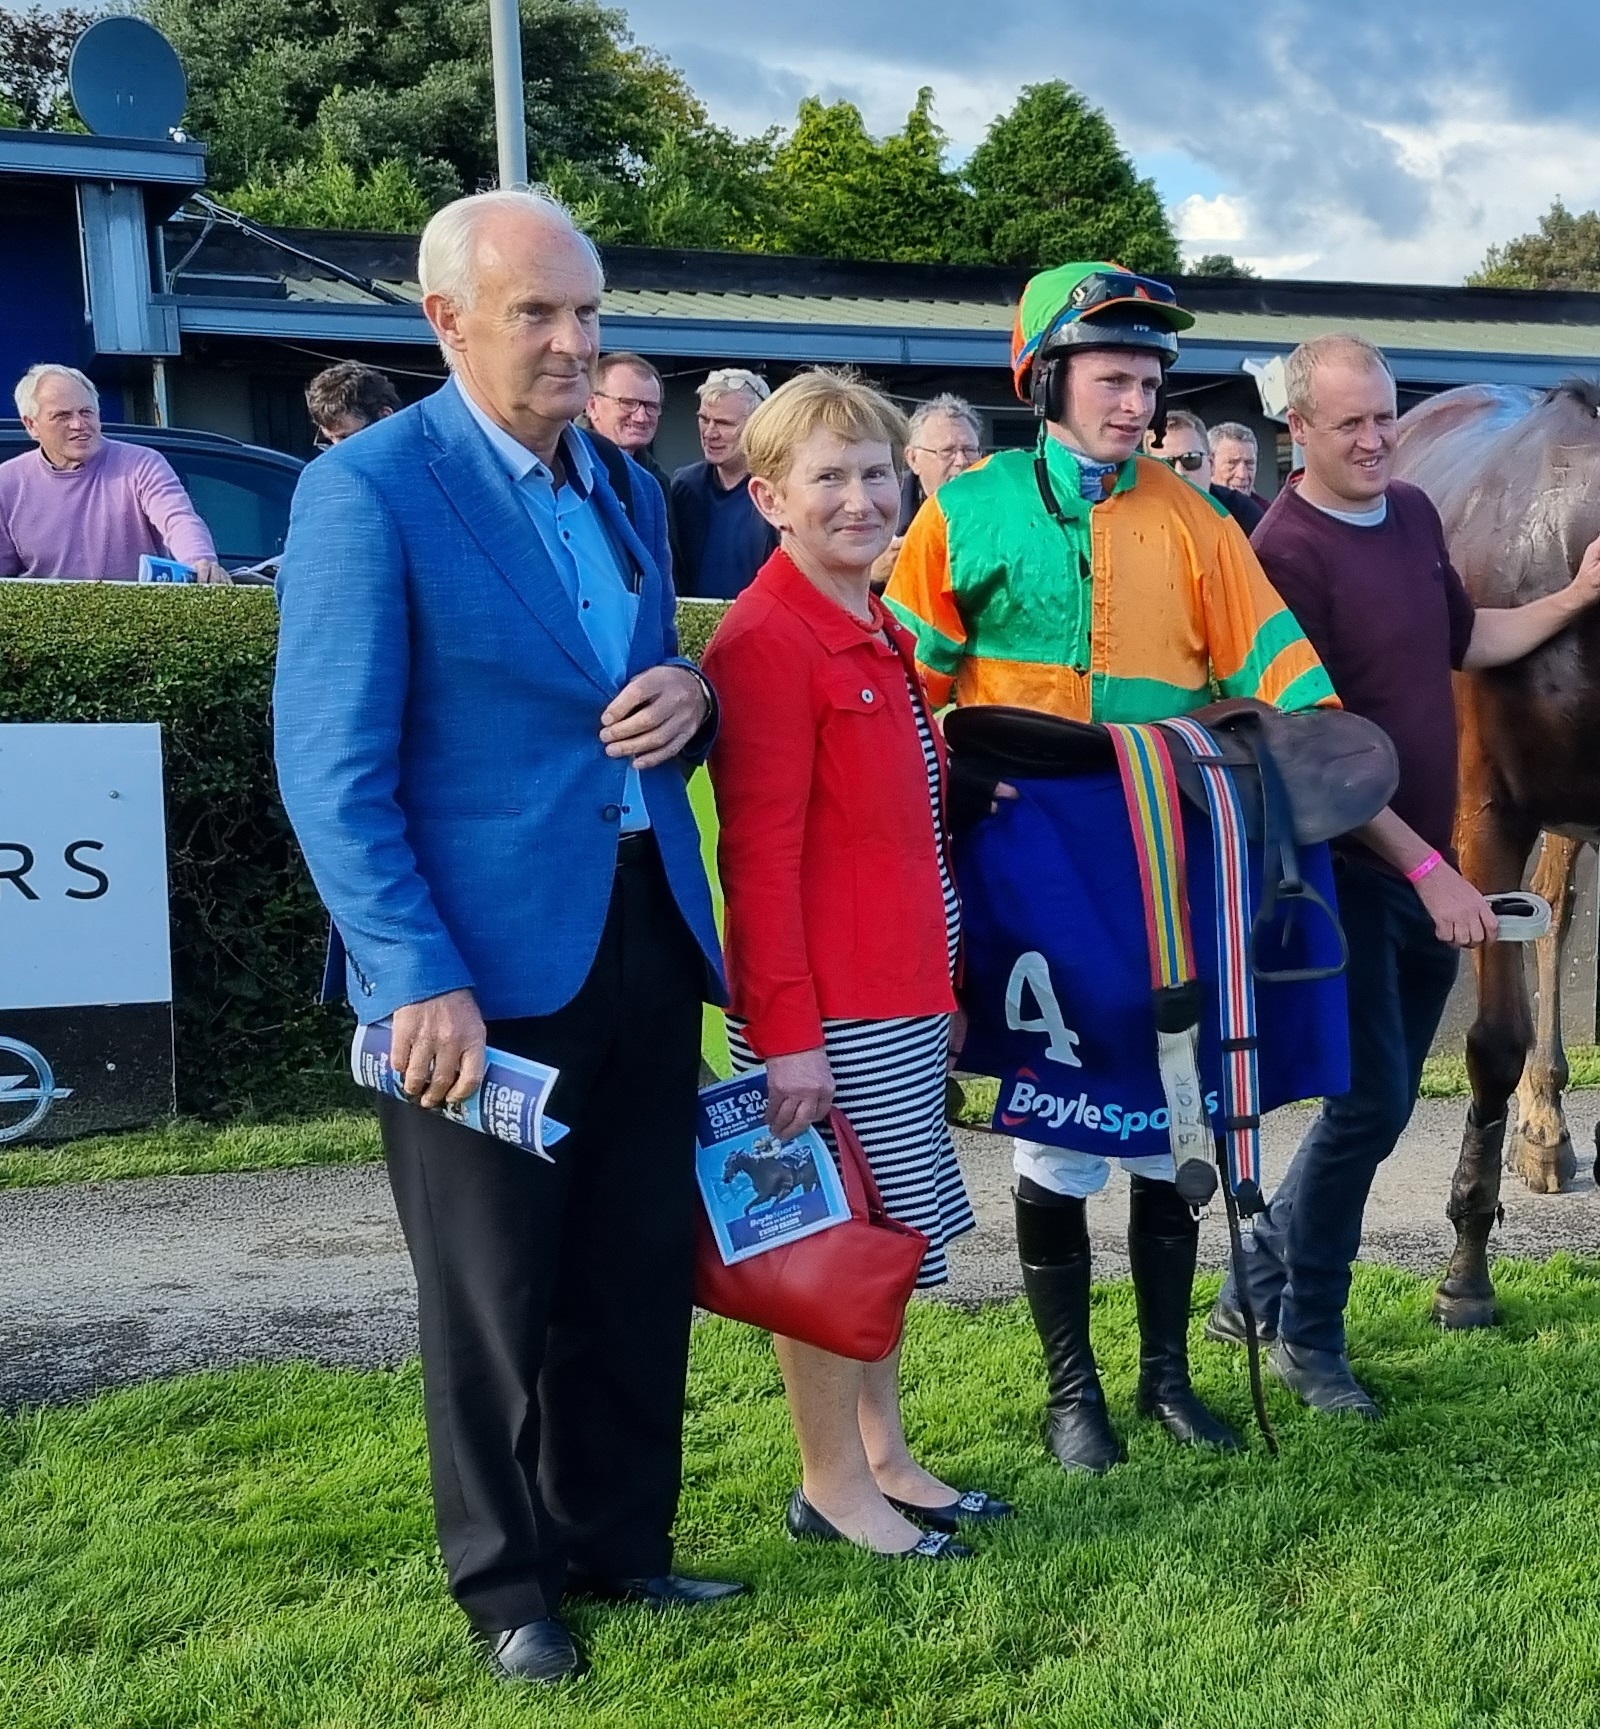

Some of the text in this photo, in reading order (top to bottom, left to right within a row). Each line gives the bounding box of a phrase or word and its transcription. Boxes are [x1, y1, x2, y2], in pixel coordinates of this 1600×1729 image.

[1005, 950, 1083, 1068] 4
[495, 1086, 511, 1121] GET
[508, 1089, 526, 1124] BET
[705, 1097, 736, 1118] BET
[738, 1089, 762, 1105] €10
[710, 1107, 743, 1128] GET
[1007, 1081, 1219, 1141] BoyleSpos
